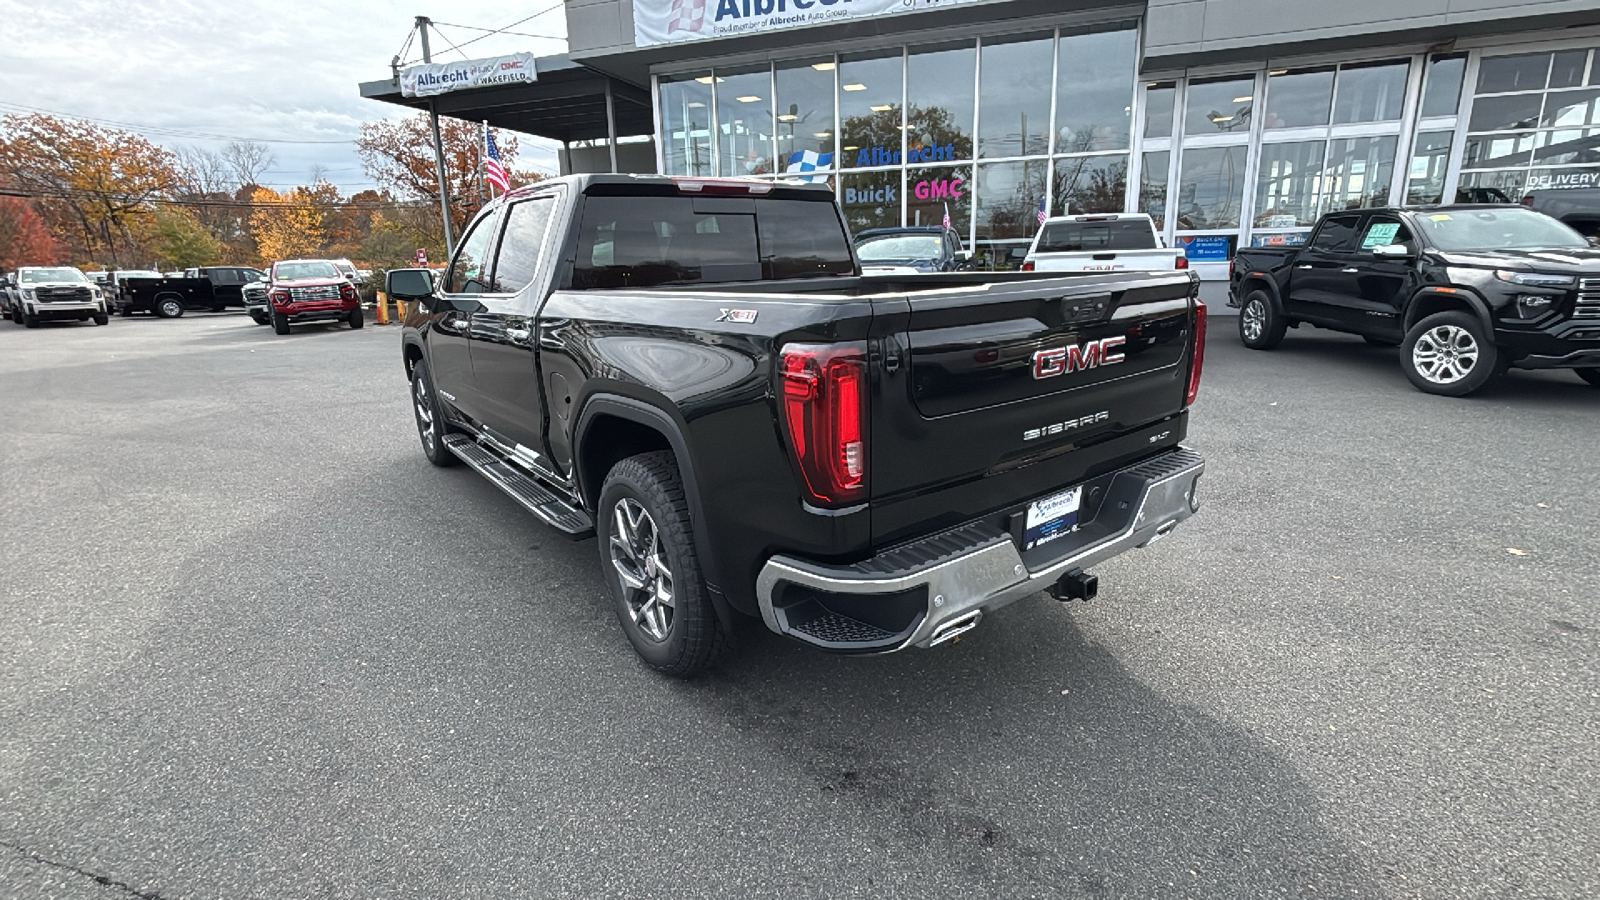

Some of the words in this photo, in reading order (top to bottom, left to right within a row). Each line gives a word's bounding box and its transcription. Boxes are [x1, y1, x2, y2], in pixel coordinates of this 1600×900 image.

[713, 23, 732, 34] Proud
[733, 21, 760, 32] member
[760, 20, 769, 28] of
[769, 14, 806, 26] Albrecht
[808, 11, 825, 20] Auto
[825, 9, 848, 19] Group
[500, 61, 524, 71] GMC
[417, 69, 469, 86] Albrecht
[480, 72, 526, 85] WAKEFIELD
[856, 142, 955, 167] Albrecht
[1529, 172, 1600, 186] DELIVERY
[845, 185, 897, 204] Buick
[914, 179, 963, 200] GMC
[1032, 335, 1126, 380] GMC
[1023, 410, 1109, 441] SIERRA
[1149, 430, 1171, 443] SLT
